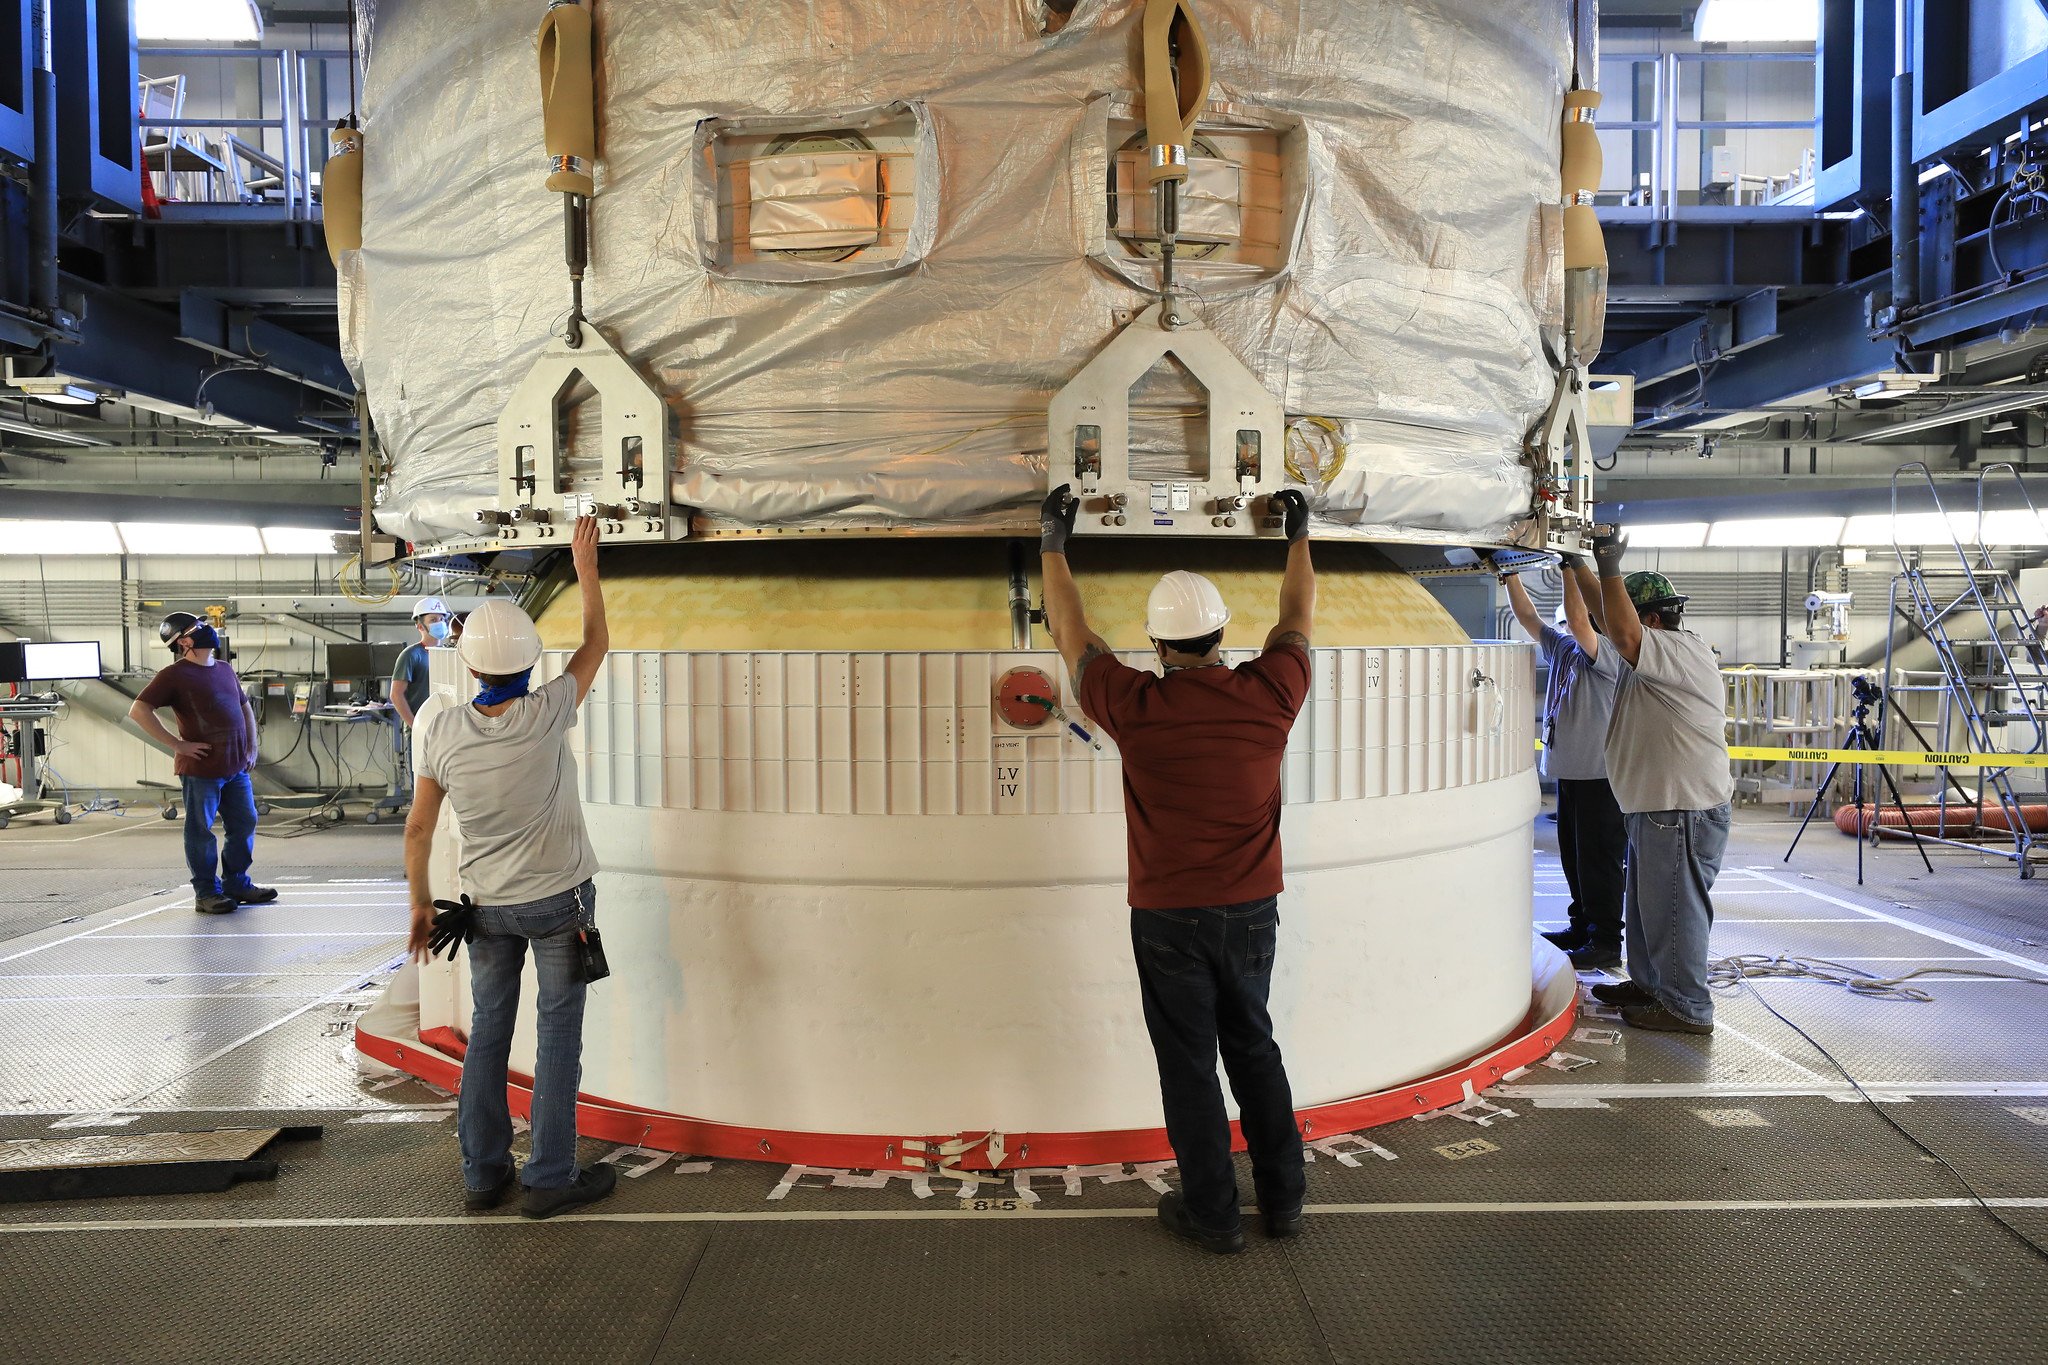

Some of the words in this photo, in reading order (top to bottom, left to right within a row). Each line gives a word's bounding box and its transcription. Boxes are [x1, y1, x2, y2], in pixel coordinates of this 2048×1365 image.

[1367, 657, 1379, 668] US
[1368, 676, 1380, 688] IV
[1788, 750, 1828, 760] CAUTION
[1925, 754, 1969, 764] CAUTION
[997, 767, 1019, 780] LV
[1001, 784, 1018, 796] IV
[994, 1140, 1000, 1149] N
